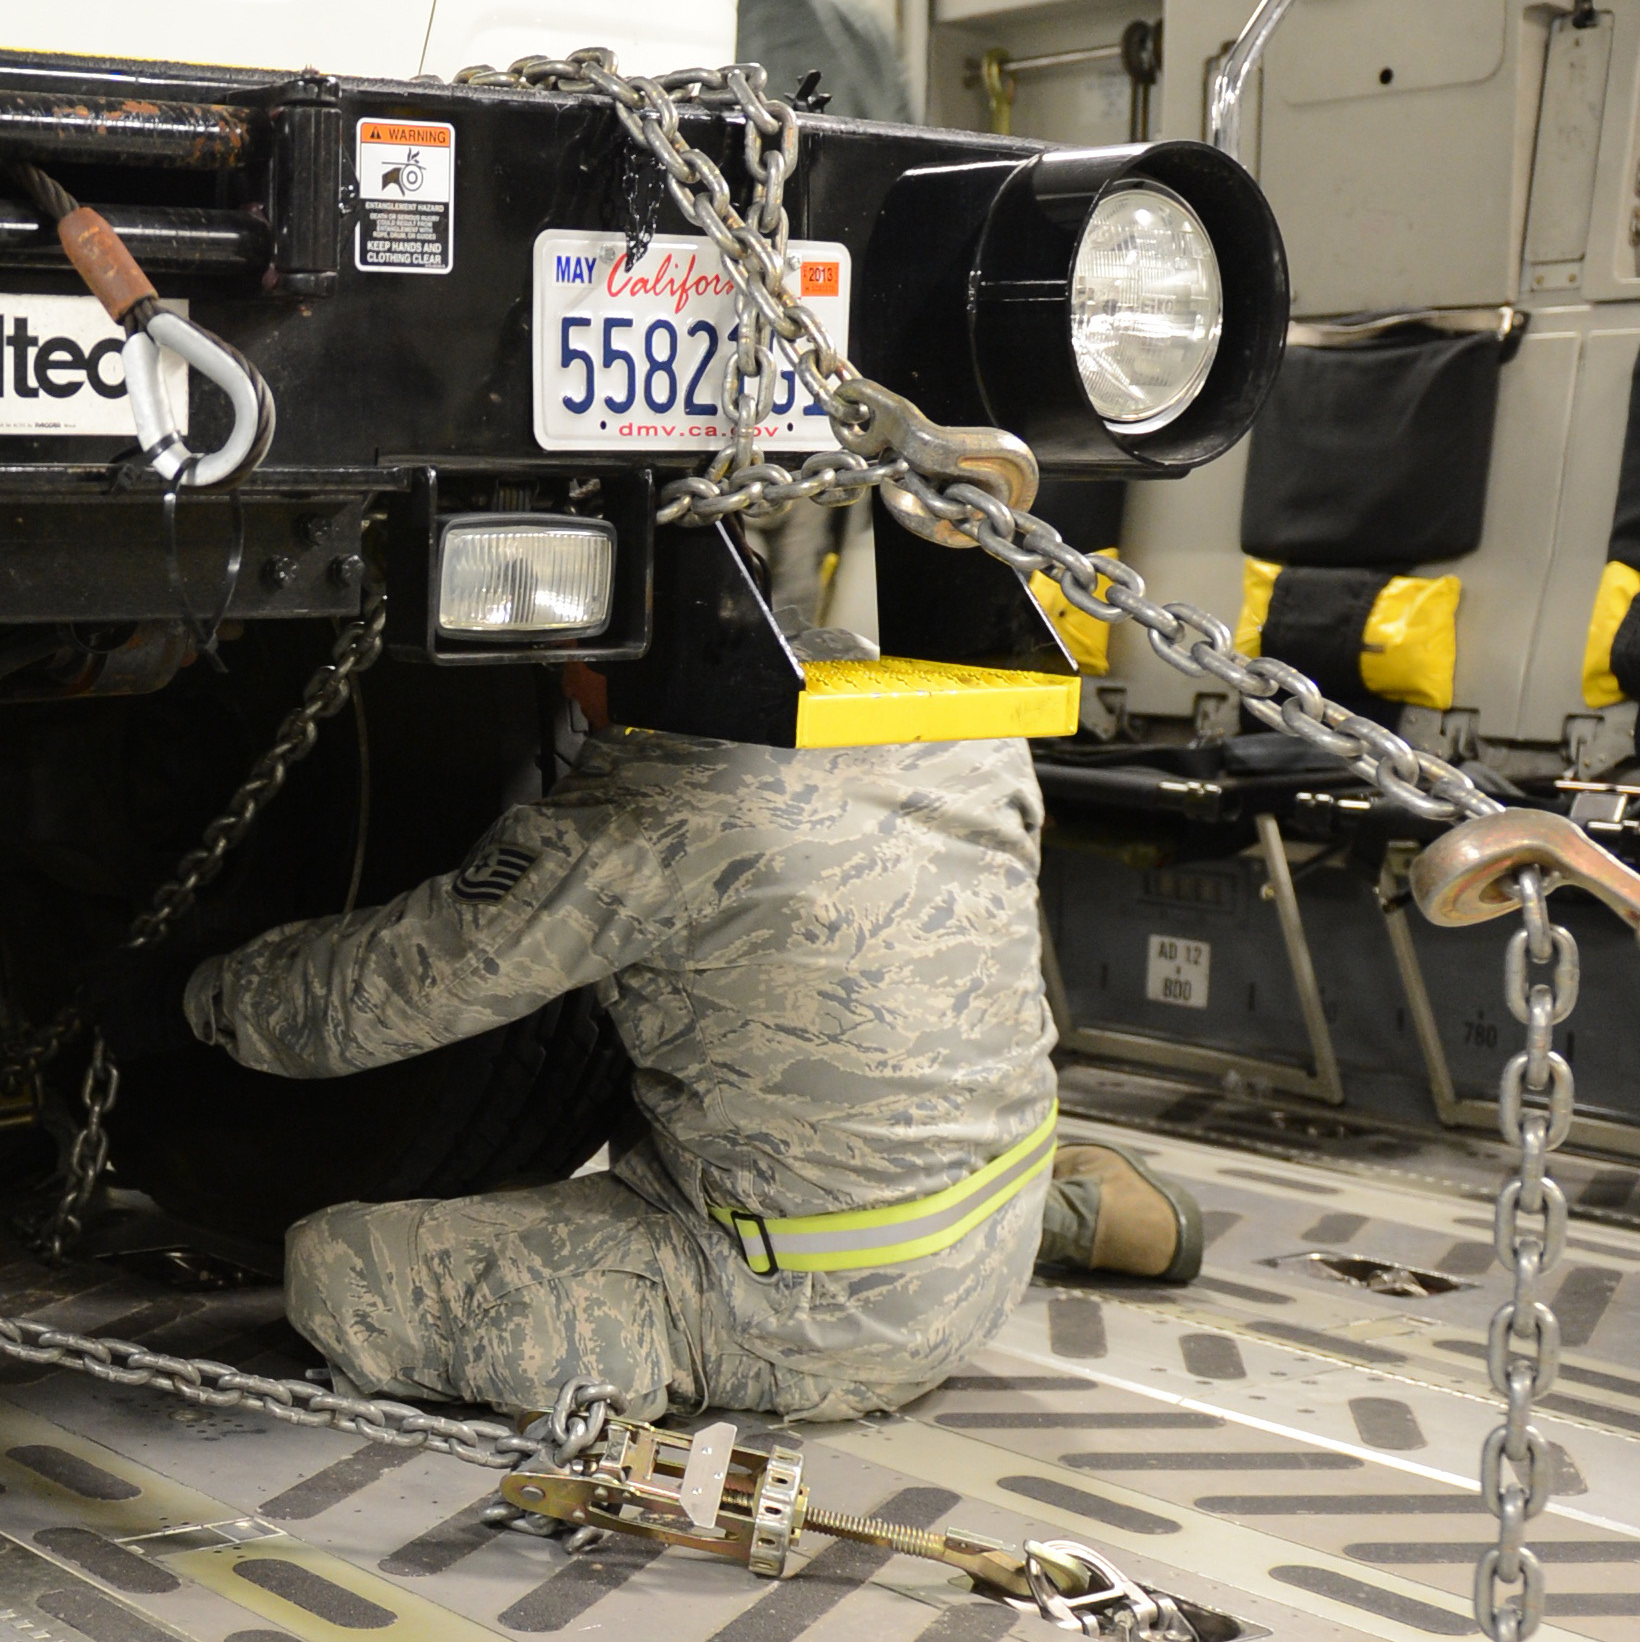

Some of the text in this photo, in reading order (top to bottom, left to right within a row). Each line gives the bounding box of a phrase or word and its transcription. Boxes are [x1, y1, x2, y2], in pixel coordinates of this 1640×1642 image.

[389, 128, 446, 144] WARNING
[365, 201, 445, 213] ENTANGLEMENT HAZARD
[366, 240, 443, 254] KEEP HANDS AND
[366, 252, 443, 265] CLOTHING CLEAR
[556, 255, 597, 284] MAY
[808, 267, 834, 282] 2013
[1159, 941, 1202, 965] AD 12
[1464, 1022, 1498, 1049] 780
